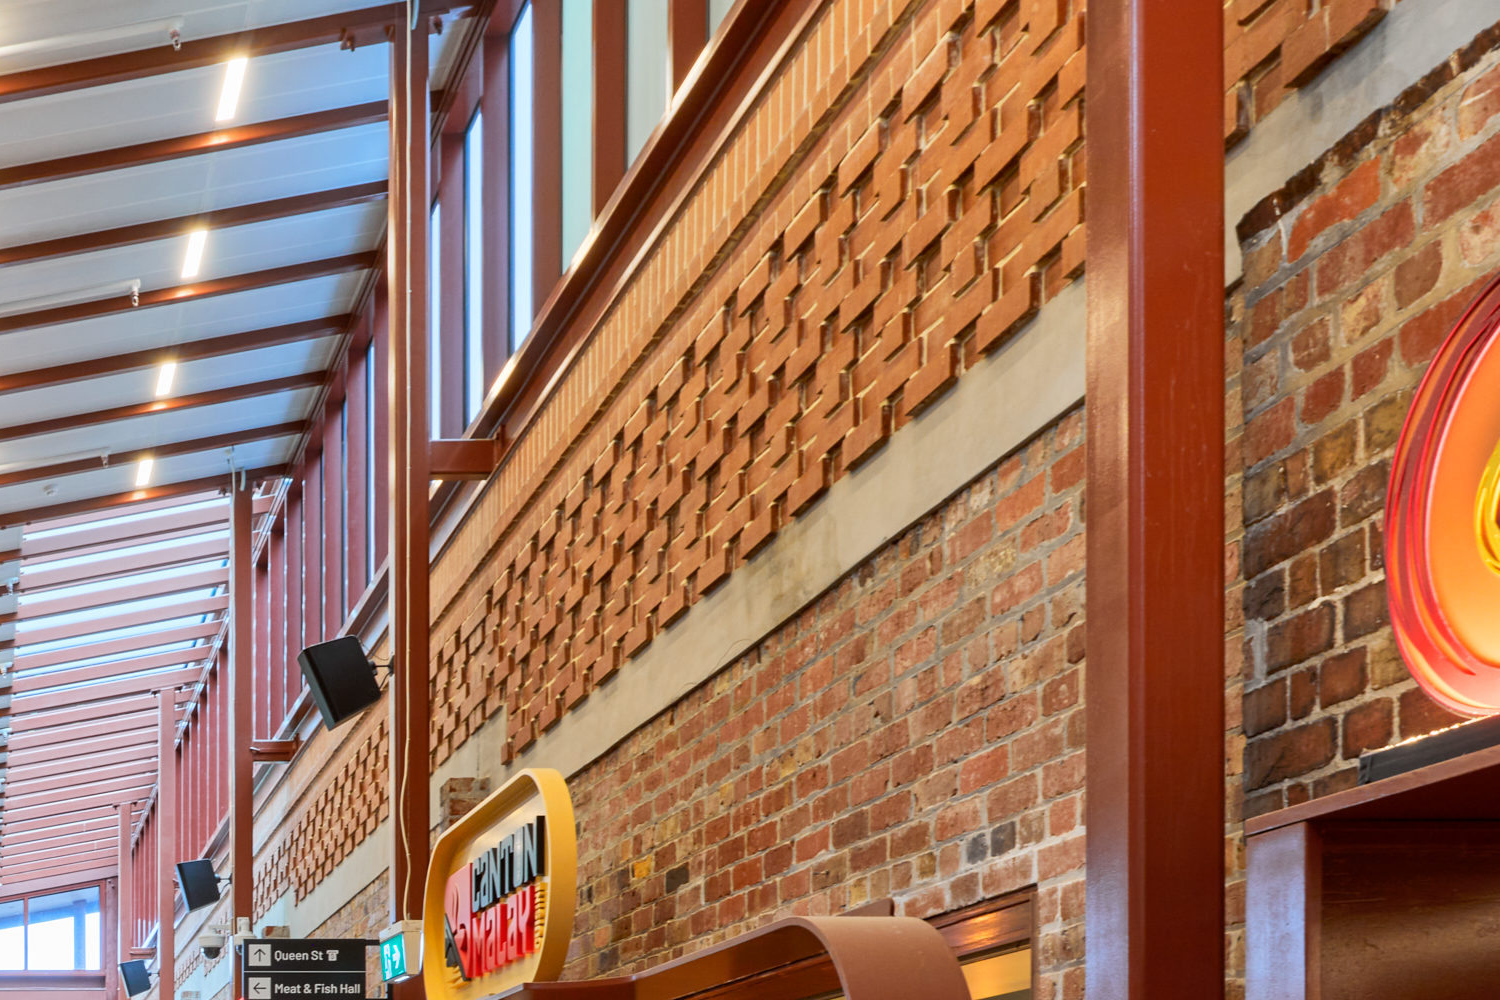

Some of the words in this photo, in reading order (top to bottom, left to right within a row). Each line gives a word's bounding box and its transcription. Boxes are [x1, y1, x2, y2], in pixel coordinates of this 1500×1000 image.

[274, 950, 309, 962] Queen
[311, 950, 324, 961] St
[274, 983, 301, 994] Meat
[303, 983, 312, 994] &
[314, 983, 338, 994] Fish
[340, 983, 361, 994] Hall
